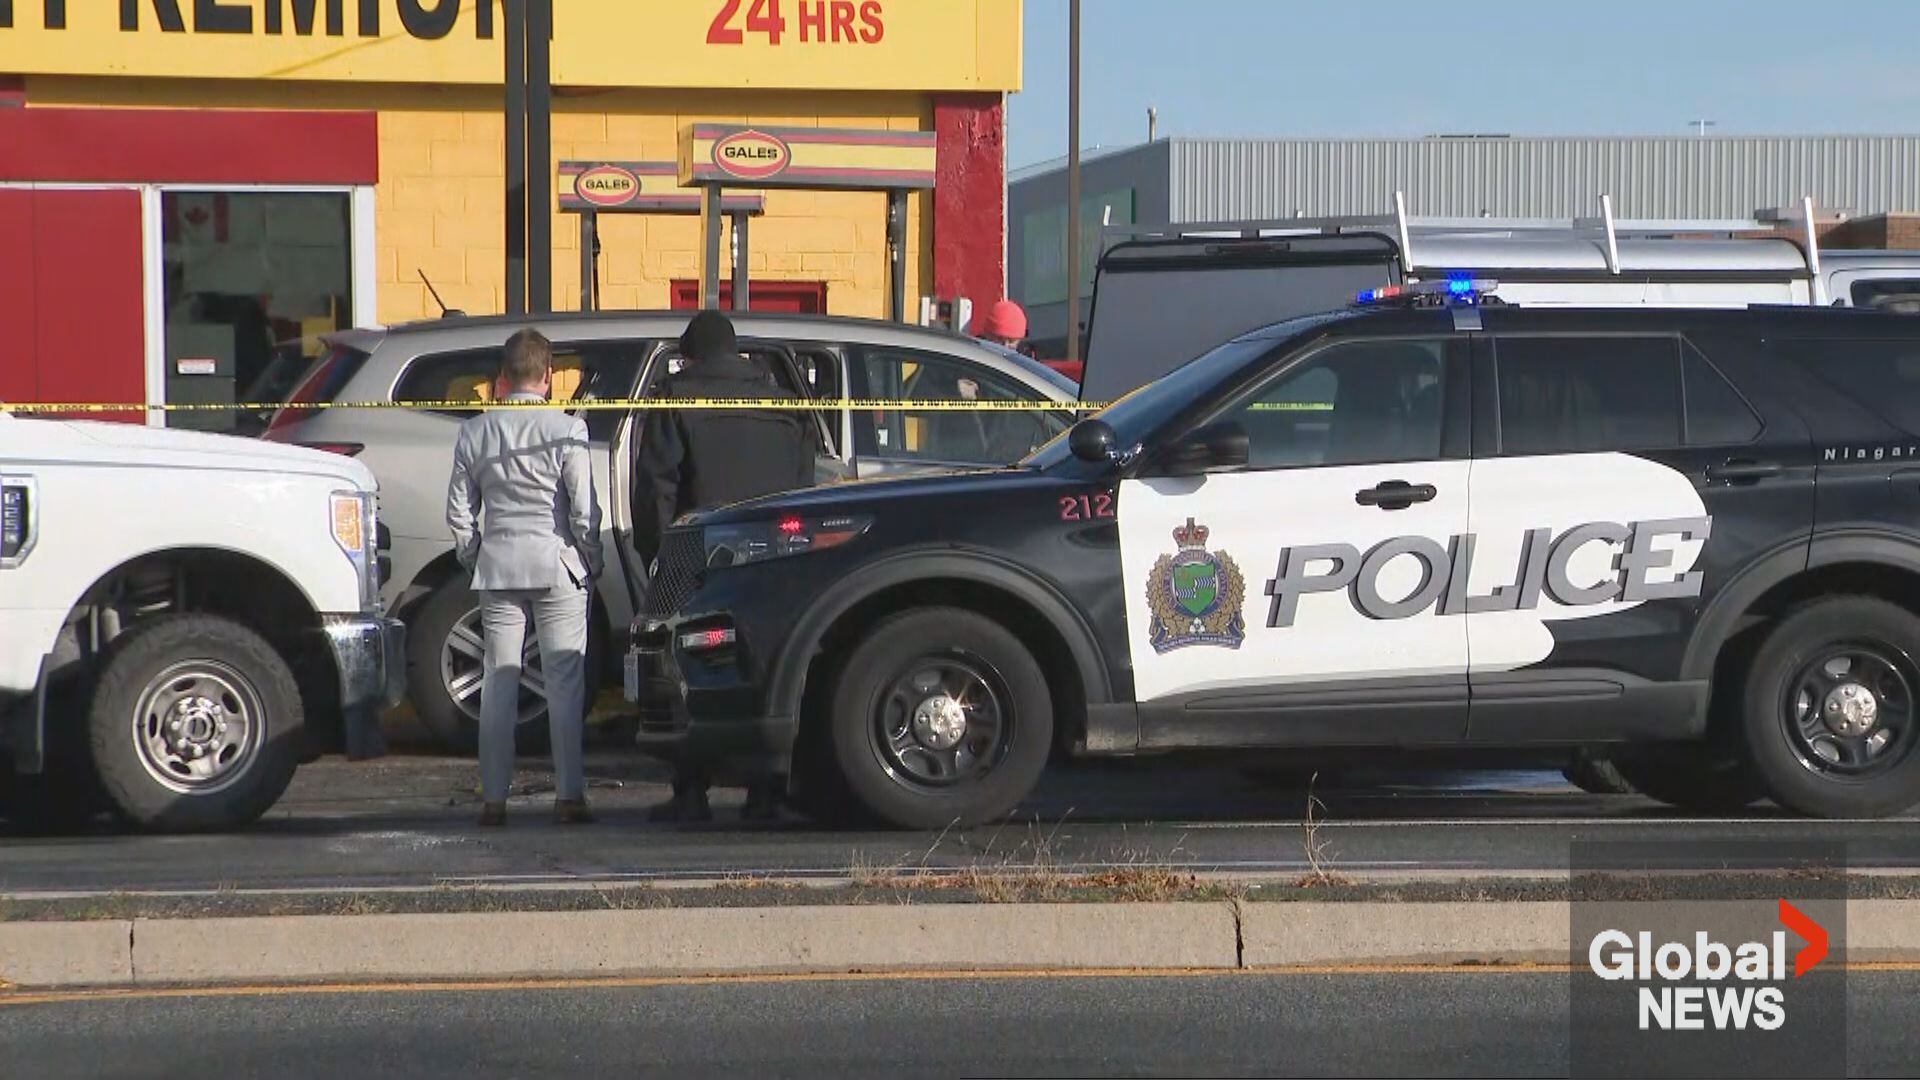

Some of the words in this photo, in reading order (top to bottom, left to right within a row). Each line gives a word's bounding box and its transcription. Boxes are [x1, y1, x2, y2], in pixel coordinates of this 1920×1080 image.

[706, 0, 785, 45] 24
[799, 0, 884, 44] HRS
[724, 146, 778, 159] GALES
[585, 178, 630, 190] GALES
[1059, 494, 1114, 520] 212
[1264, 515, 1712, 627] POLICE
